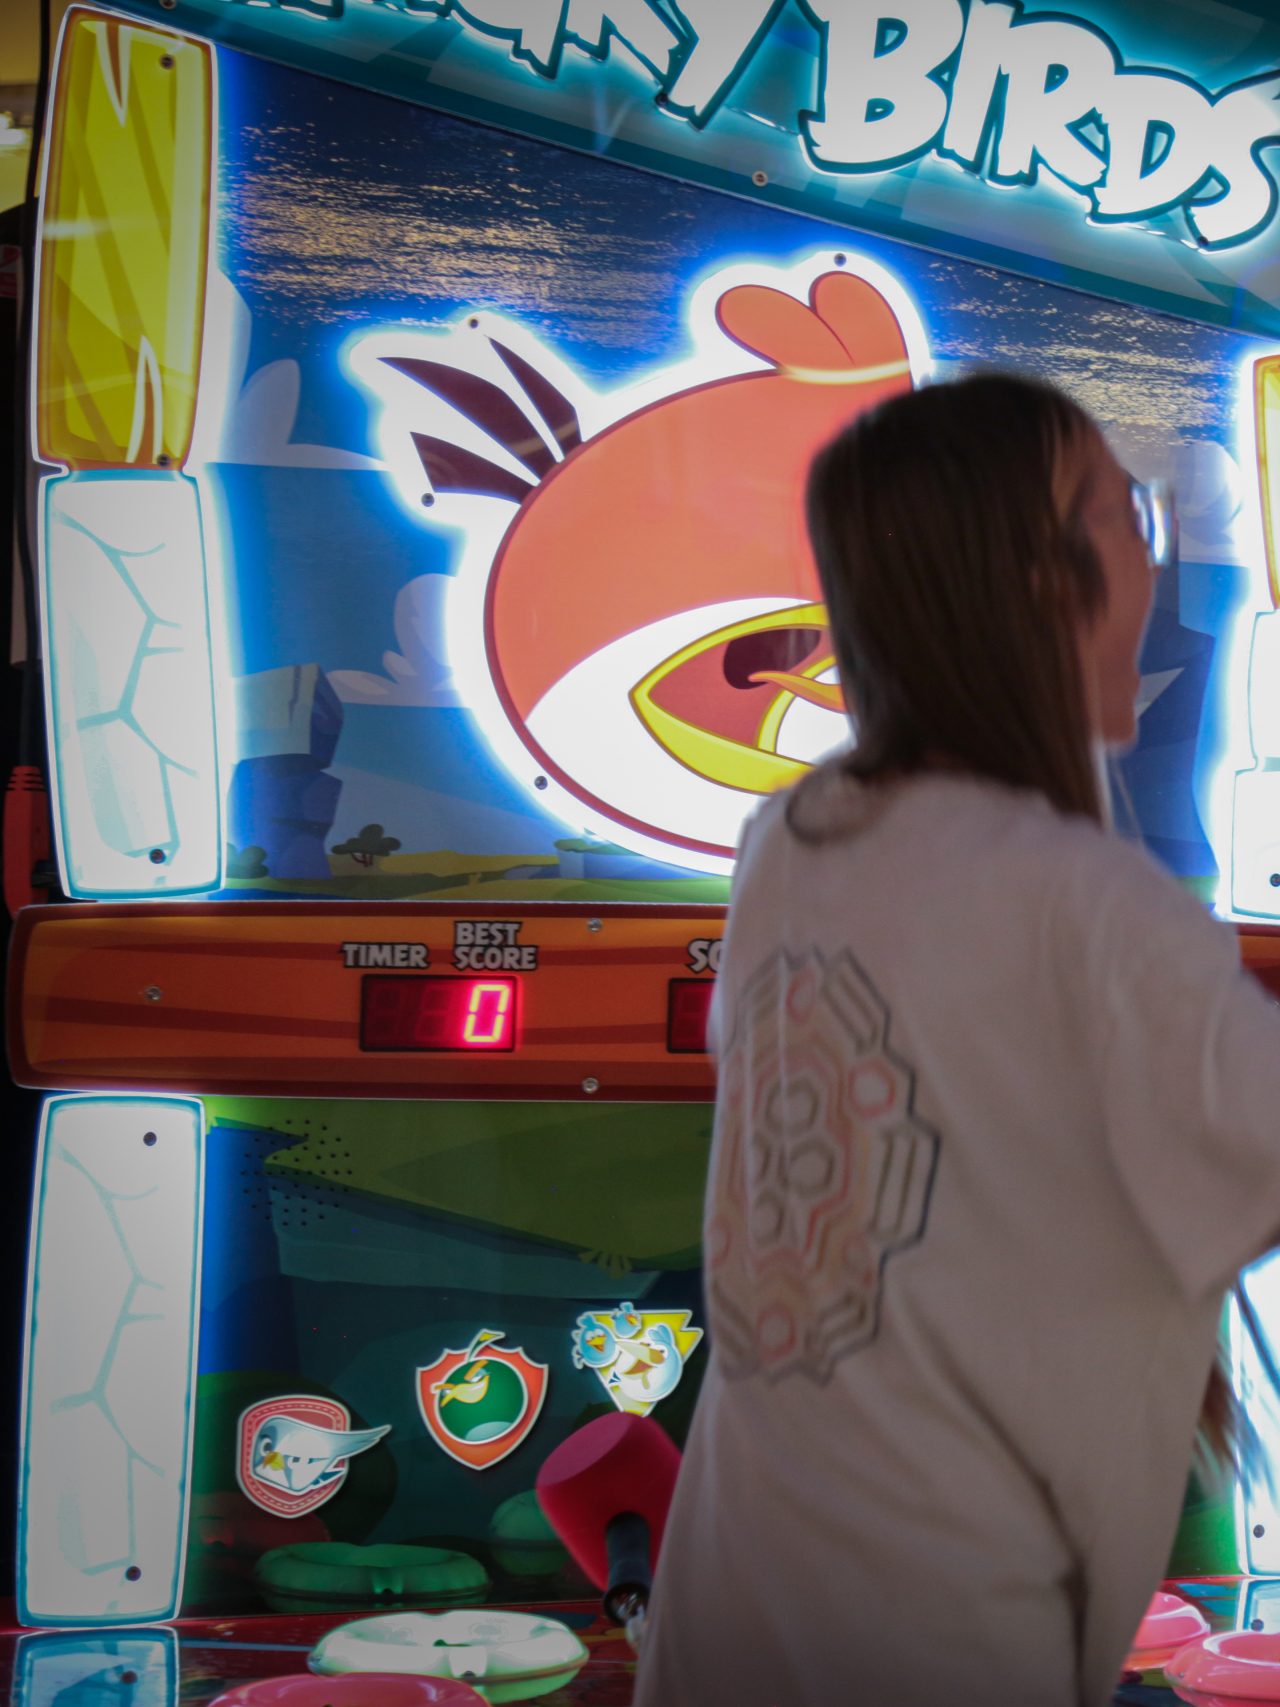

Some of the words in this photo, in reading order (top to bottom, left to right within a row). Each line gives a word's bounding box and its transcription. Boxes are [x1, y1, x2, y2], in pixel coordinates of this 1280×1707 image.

[455, 921, 521, 946] BEST
[342, 943, 429, 968] TIMER
[453, 946, 537, 970] SCORE
[462, 983, 511, 1043] 0
